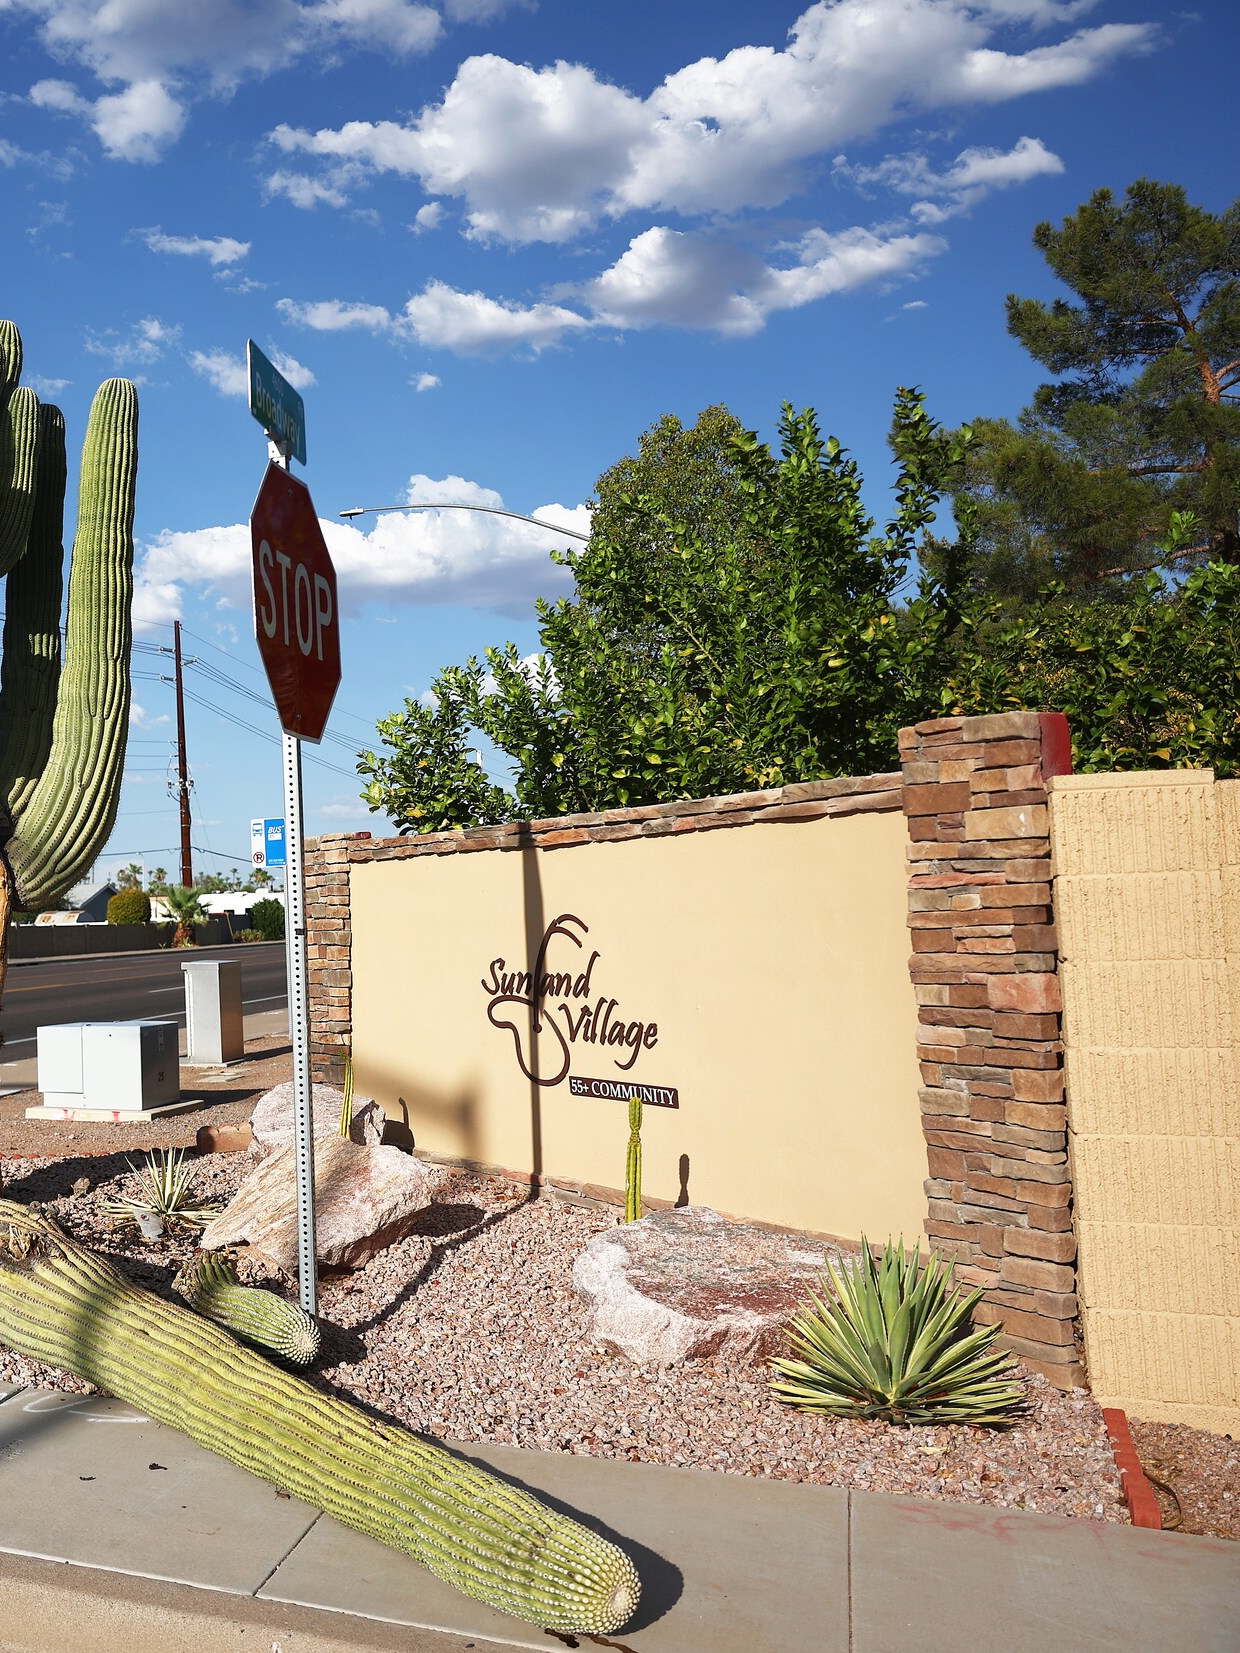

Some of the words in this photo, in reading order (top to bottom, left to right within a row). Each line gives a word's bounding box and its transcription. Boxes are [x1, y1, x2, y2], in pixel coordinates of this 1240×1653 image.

[255, 370, 301, 455] Broadway
[259, 539, 332, 661] STOP
[268, 825, 282, 834] BUS
[481, 940, 601, 1002] Sunland
[557, 996, 658, 1070] Village
[571, 1079, 589, 1093] 55+
[591, 1081, 674, 1105] COMMUNITY
